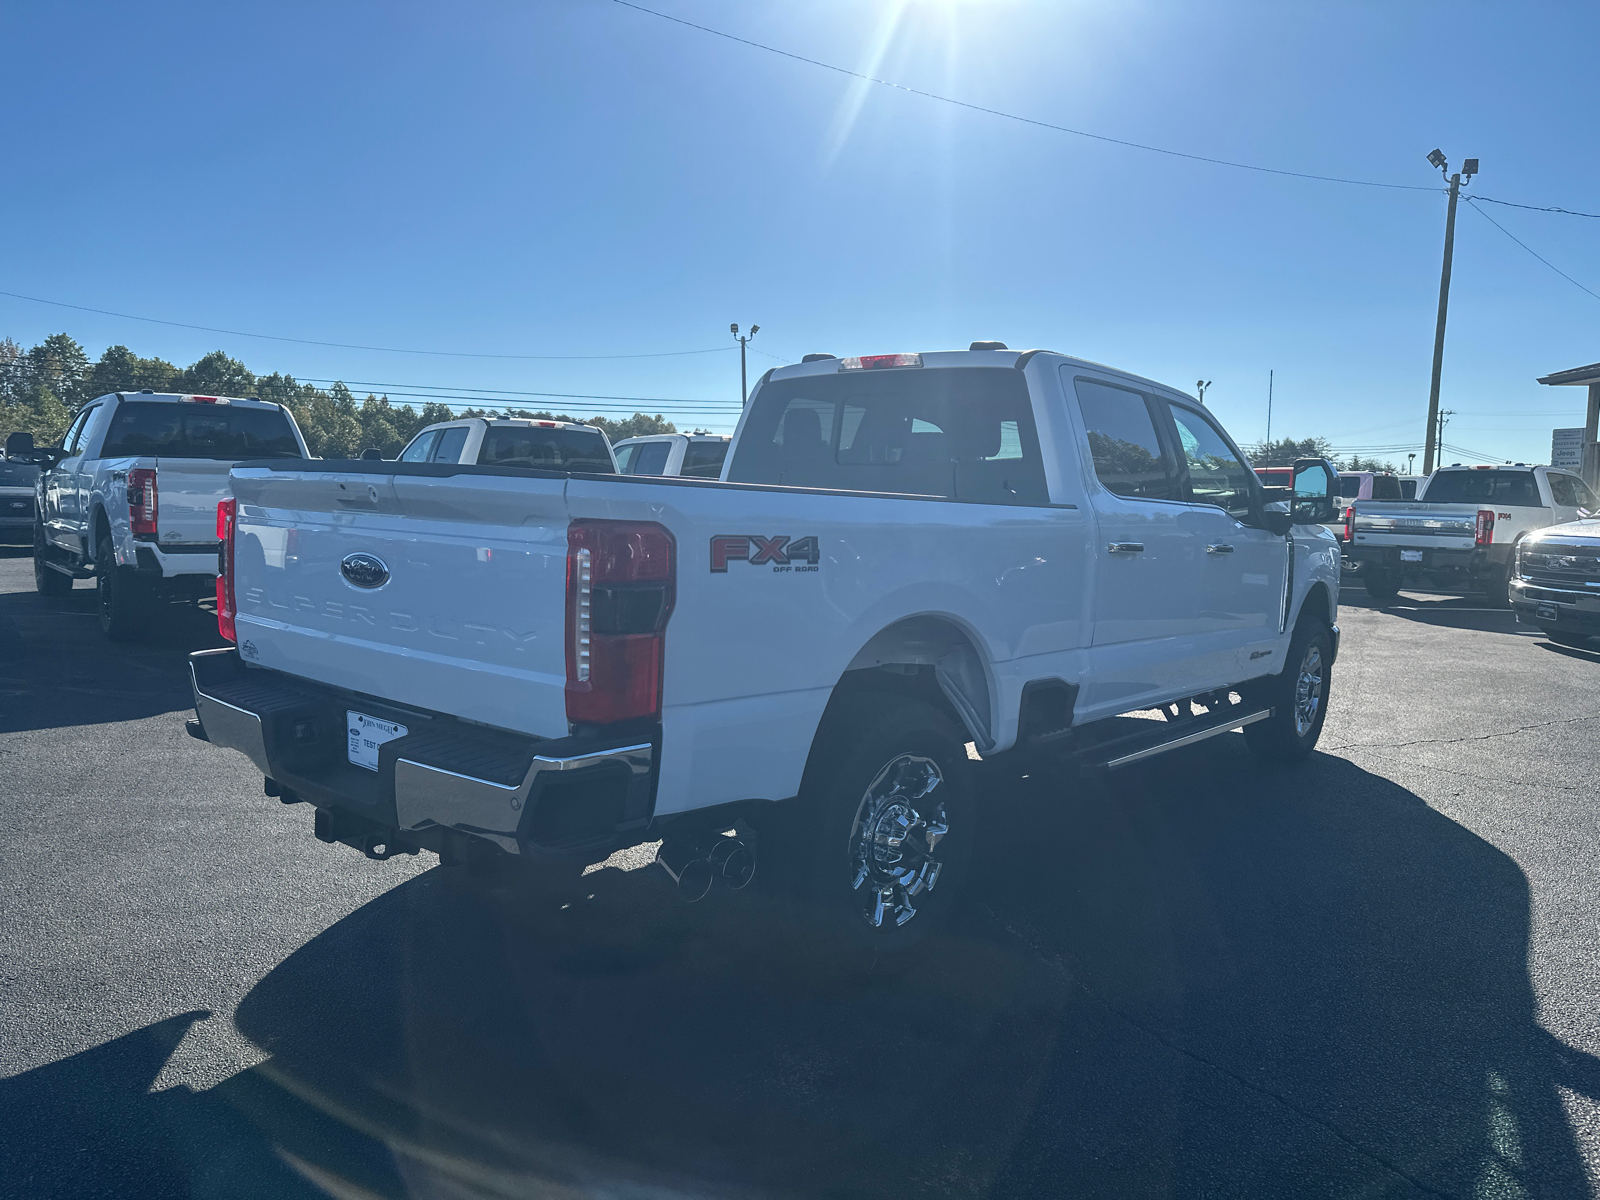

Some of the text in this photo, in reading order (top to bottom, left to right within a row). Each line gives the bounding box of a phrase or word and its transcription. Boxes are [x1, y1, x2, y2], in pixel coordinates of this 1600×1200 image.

[710, 534, 820, 573] FX4
[794, 565, 819, 573] ROAD
[246, 587, 538, 651] SUPER DUTY
[363, 719, 394, 736] JOHN MEGEL
[363, 739, 376, 750] TEST
